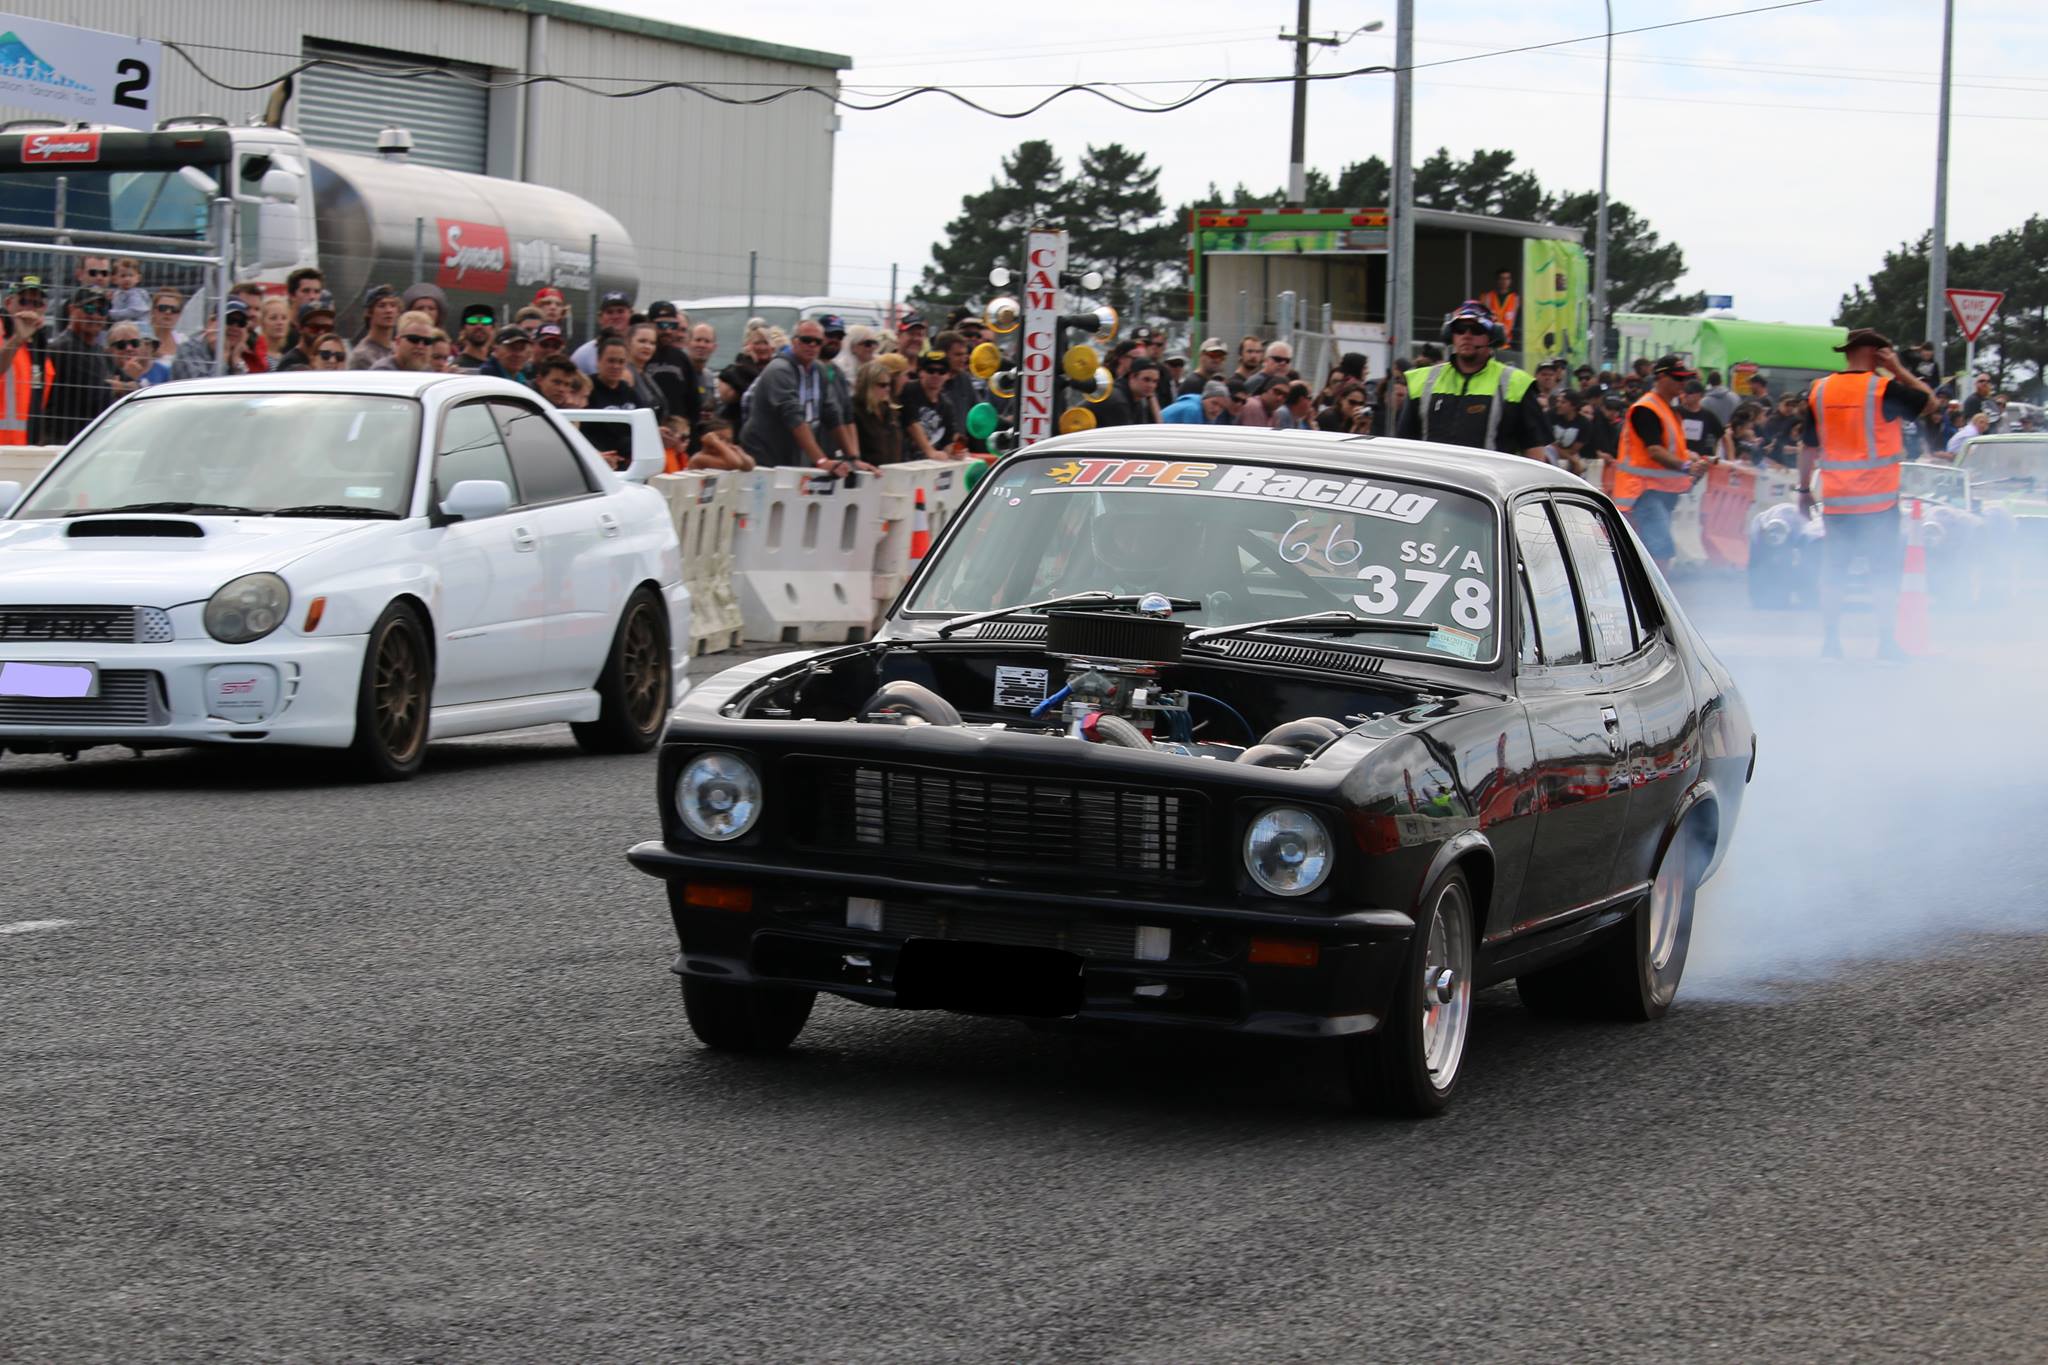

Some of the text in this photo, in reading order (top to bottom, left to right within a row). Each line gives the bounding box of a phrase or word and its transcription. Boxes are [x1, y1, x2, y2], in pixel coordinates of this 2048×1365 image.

[113, 58, 150, 110] 2
[1026, 249, 1057, 310] CAM
[1070, 458, 1439, 524] TPE Racing
[1278, 518, 1363, 566] 66
[1399, 540, 1485, 575] SS/A
[1353, 565, 1492, 630] 378
